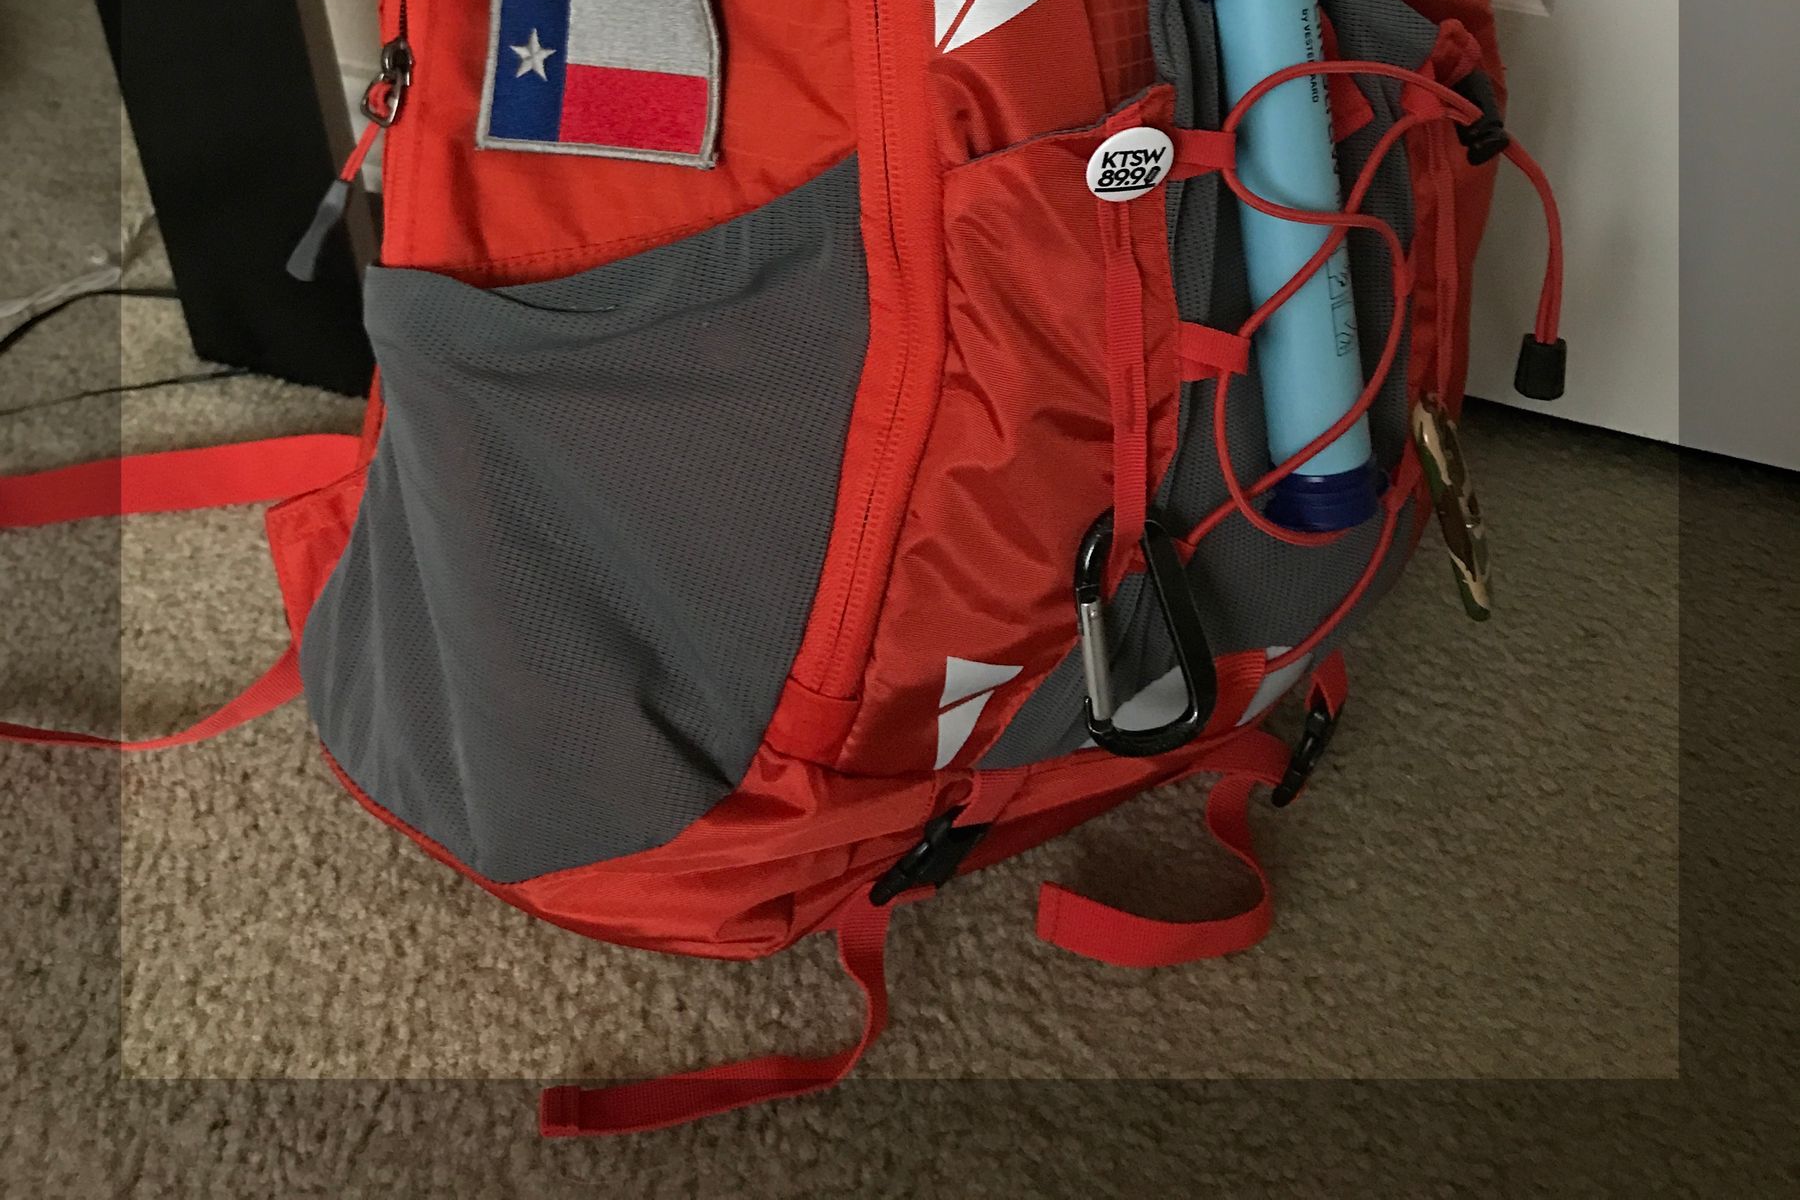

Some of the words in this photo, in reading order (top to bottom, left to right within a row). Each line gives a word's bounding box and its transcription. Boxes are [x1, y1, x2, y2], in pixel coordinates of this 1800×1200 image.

[1304, 24, 1320, 103] VESTEAARD
[1101, 147, 1166, 169] KTSW
[1097, 166, 1147, 188] 89.9
